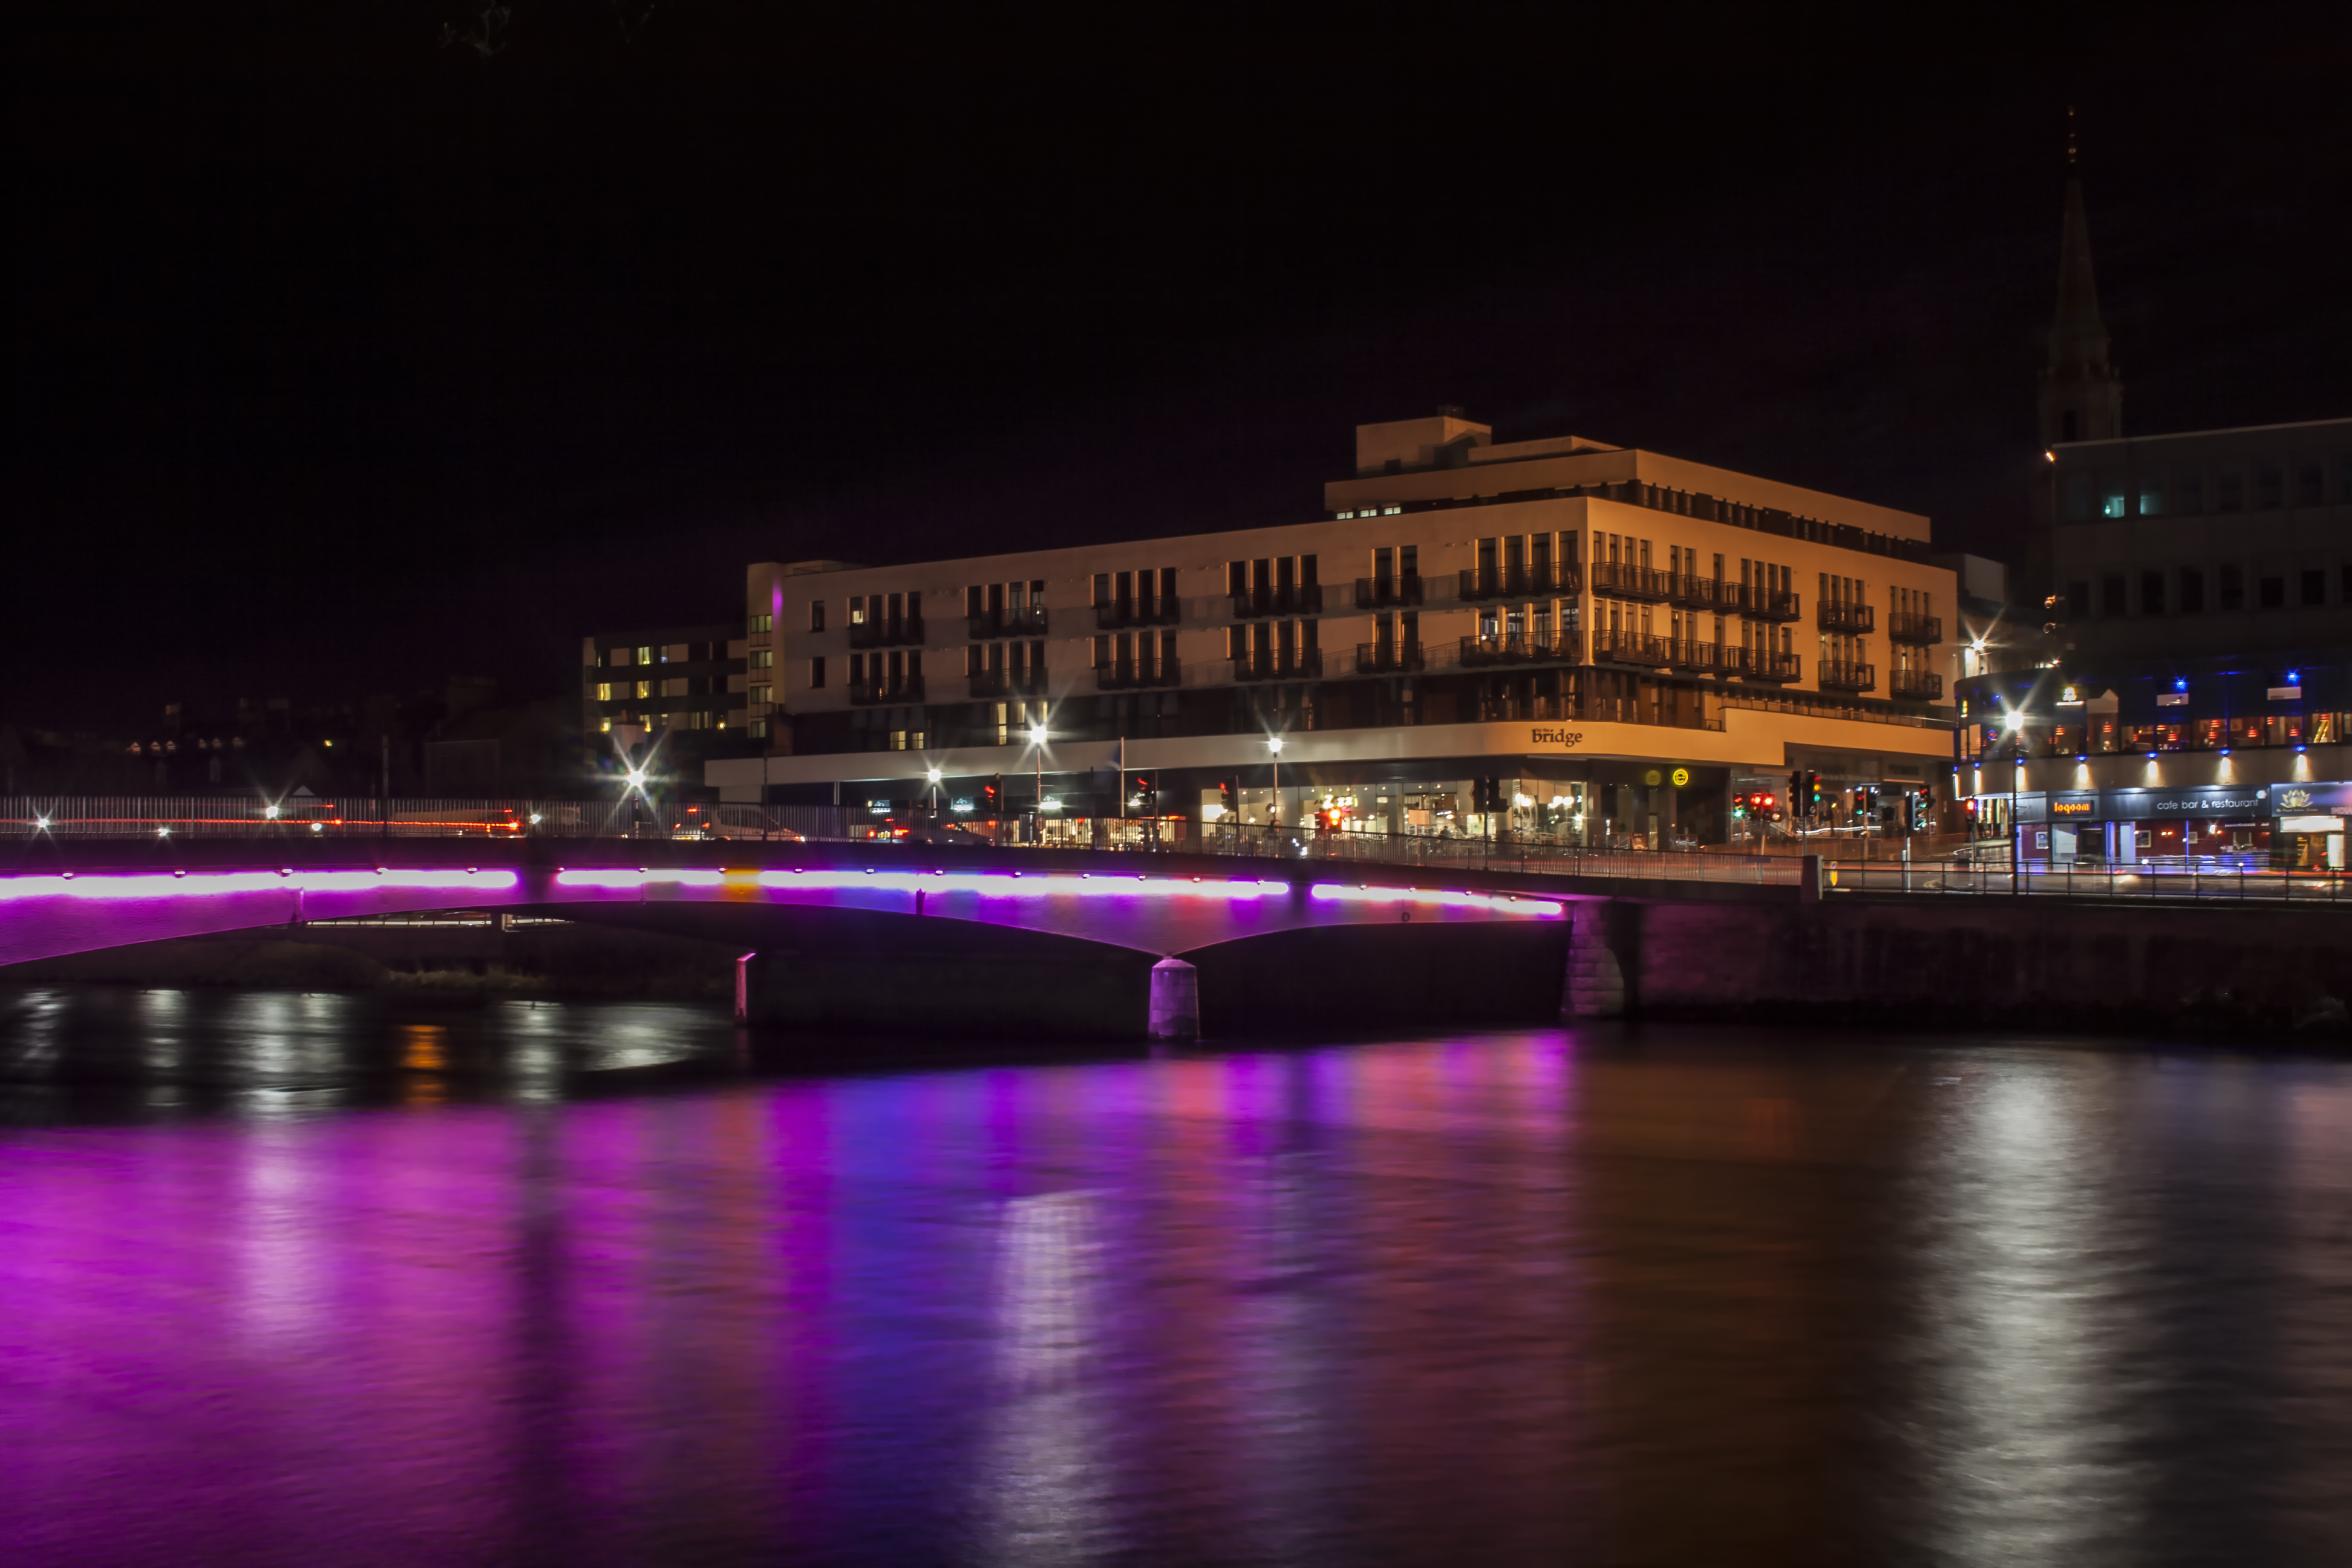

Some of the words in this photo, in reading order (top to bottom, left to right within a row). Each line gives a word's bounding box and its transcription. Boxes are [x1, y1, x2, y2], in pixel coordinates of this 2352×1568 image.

[1532, 729, 1583, 747] bridge
[2157, 800, 2178, 809] cafe
[2181, 800, 2198, 809] bar
[2201, 800, 2209, 808] &
[2211, 799, 2259, 808] restaurant
